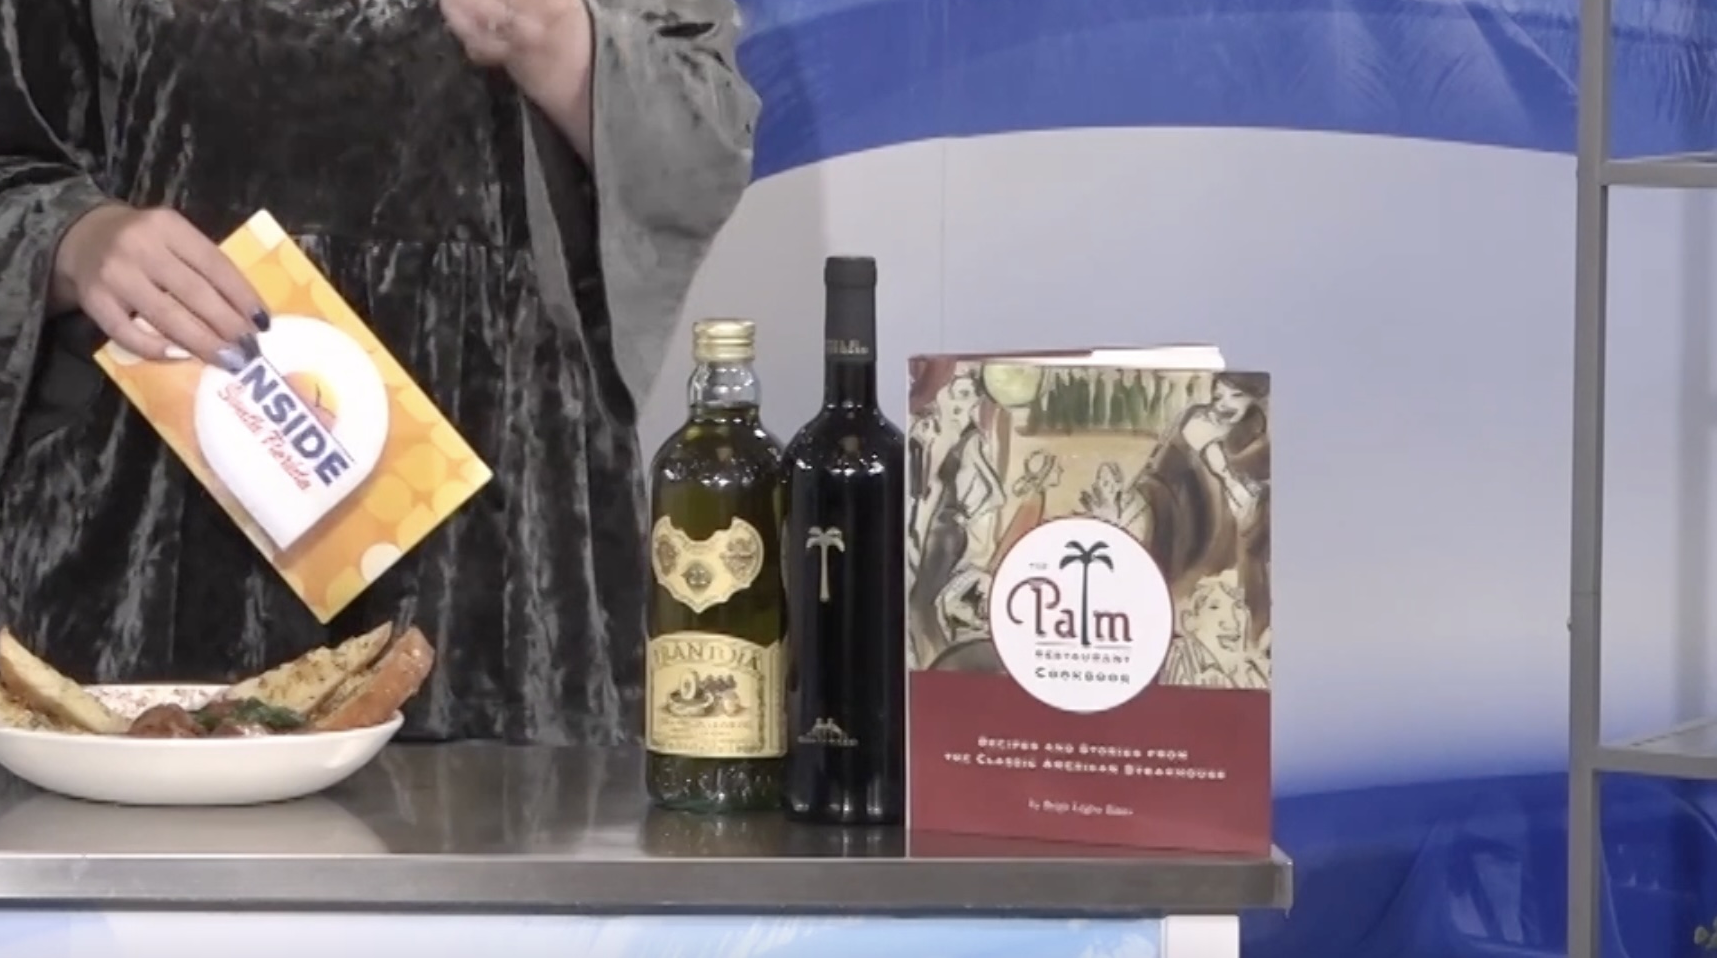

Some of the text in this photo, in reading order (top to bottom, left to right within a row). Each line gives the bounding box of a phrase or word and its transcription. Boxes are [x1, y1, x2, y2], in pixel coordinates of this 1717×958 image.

[240, 364, 350, 487] NSIDE
[1006, 540, 1134, 648] Palm
[1034, 649, 1131, 664] RESTAURANT
[1034, 667, 1131, 684] COOKBOOK
[978, 736, 1188, 760] RECIPES AND STORIES FROM
[943, 752, 1226, 780] THE CLASSIC AMERICAN STEAKHOUSE
